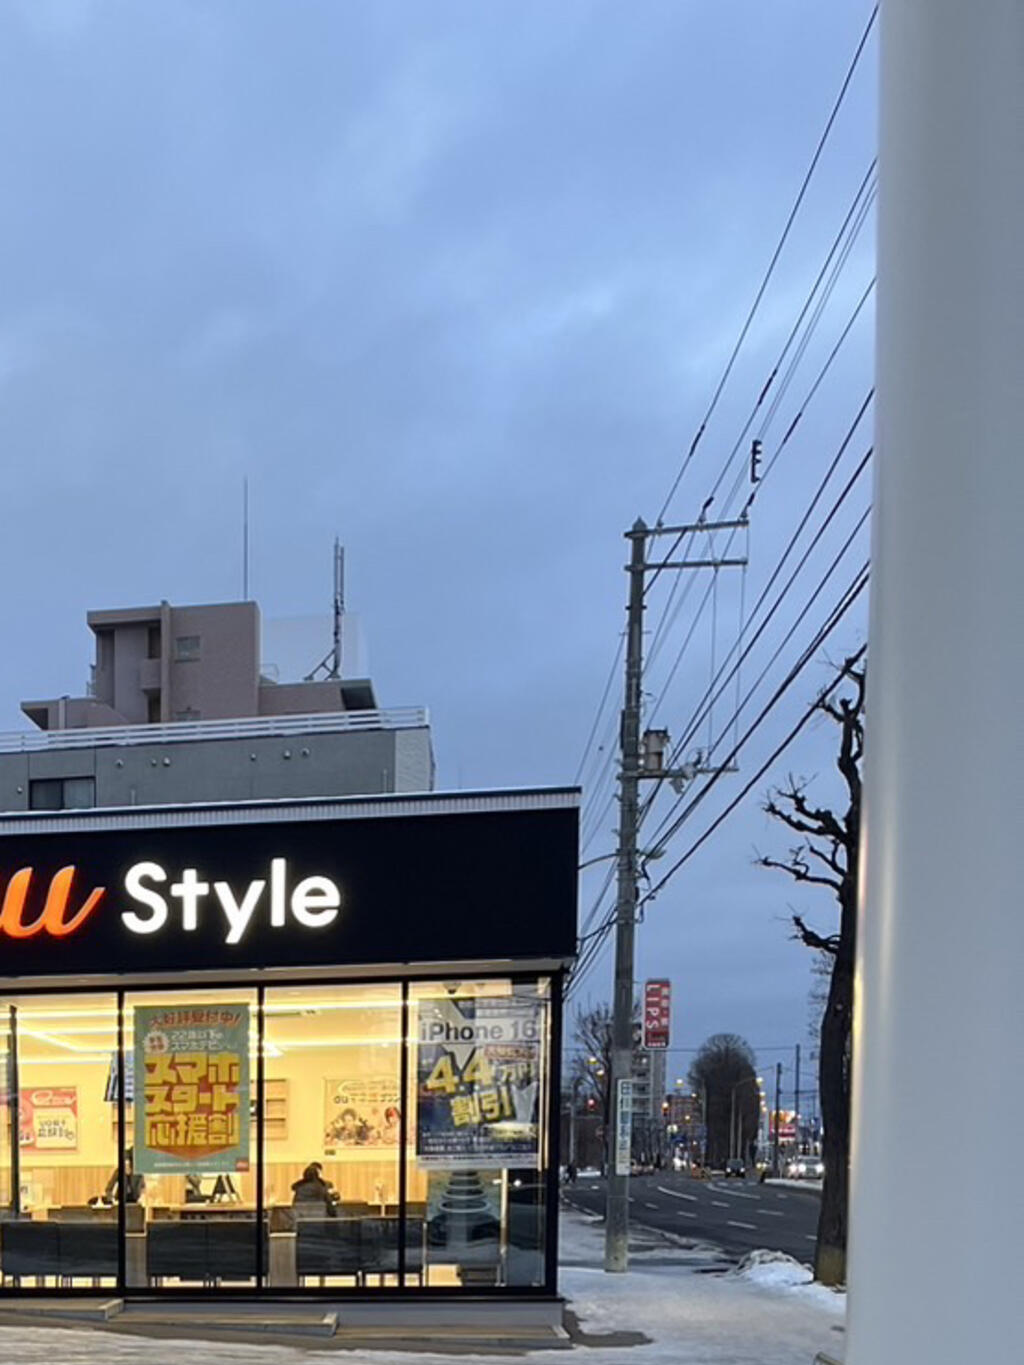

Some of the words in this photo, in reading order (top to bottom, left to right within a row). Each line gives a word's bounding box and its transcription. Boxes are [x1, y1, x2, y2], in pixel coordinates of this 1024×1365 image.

[121, 858, 341, 943] Style
[646, 984, 661, 1030] LIPS
[422, 1022, 504, 1041] iPhone
[144, 1053, 240, 1084] スマホ
[144, 1084, 240, 1115] スタート
[145, 1113, 240, 1146] 応援割
